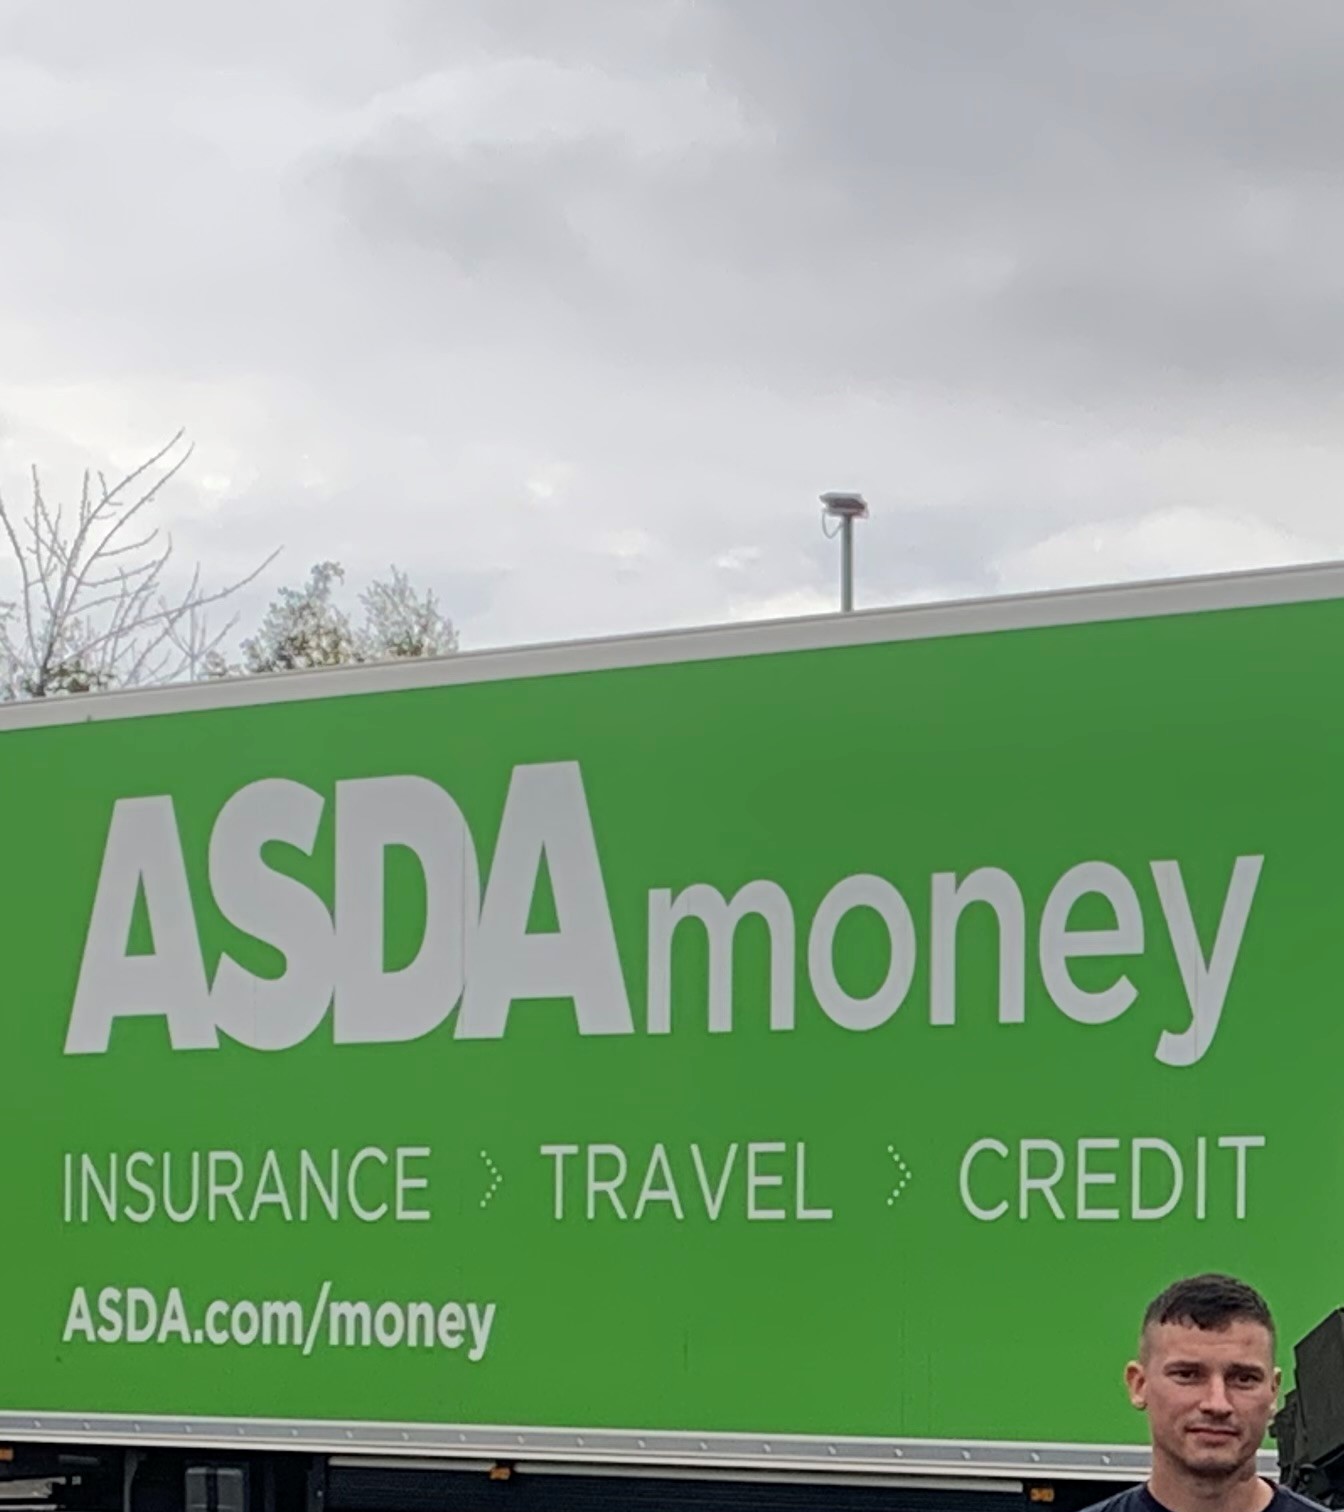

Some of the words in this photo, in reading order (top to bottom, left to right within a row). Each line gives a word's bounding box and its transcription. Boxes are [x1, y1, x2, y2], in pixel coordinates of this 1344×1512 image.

[64, 761, 635, 1055] ASDA
[647, 855, 1265, 1067] money
[64, 1147, 432, 1223] INSURANCE
[541, 1142, 834, 1221] TRAVEL
[960, 1135, 1267, 1222] CREDIT
[63, 1282, 497, 1362] ASDA.com/money
